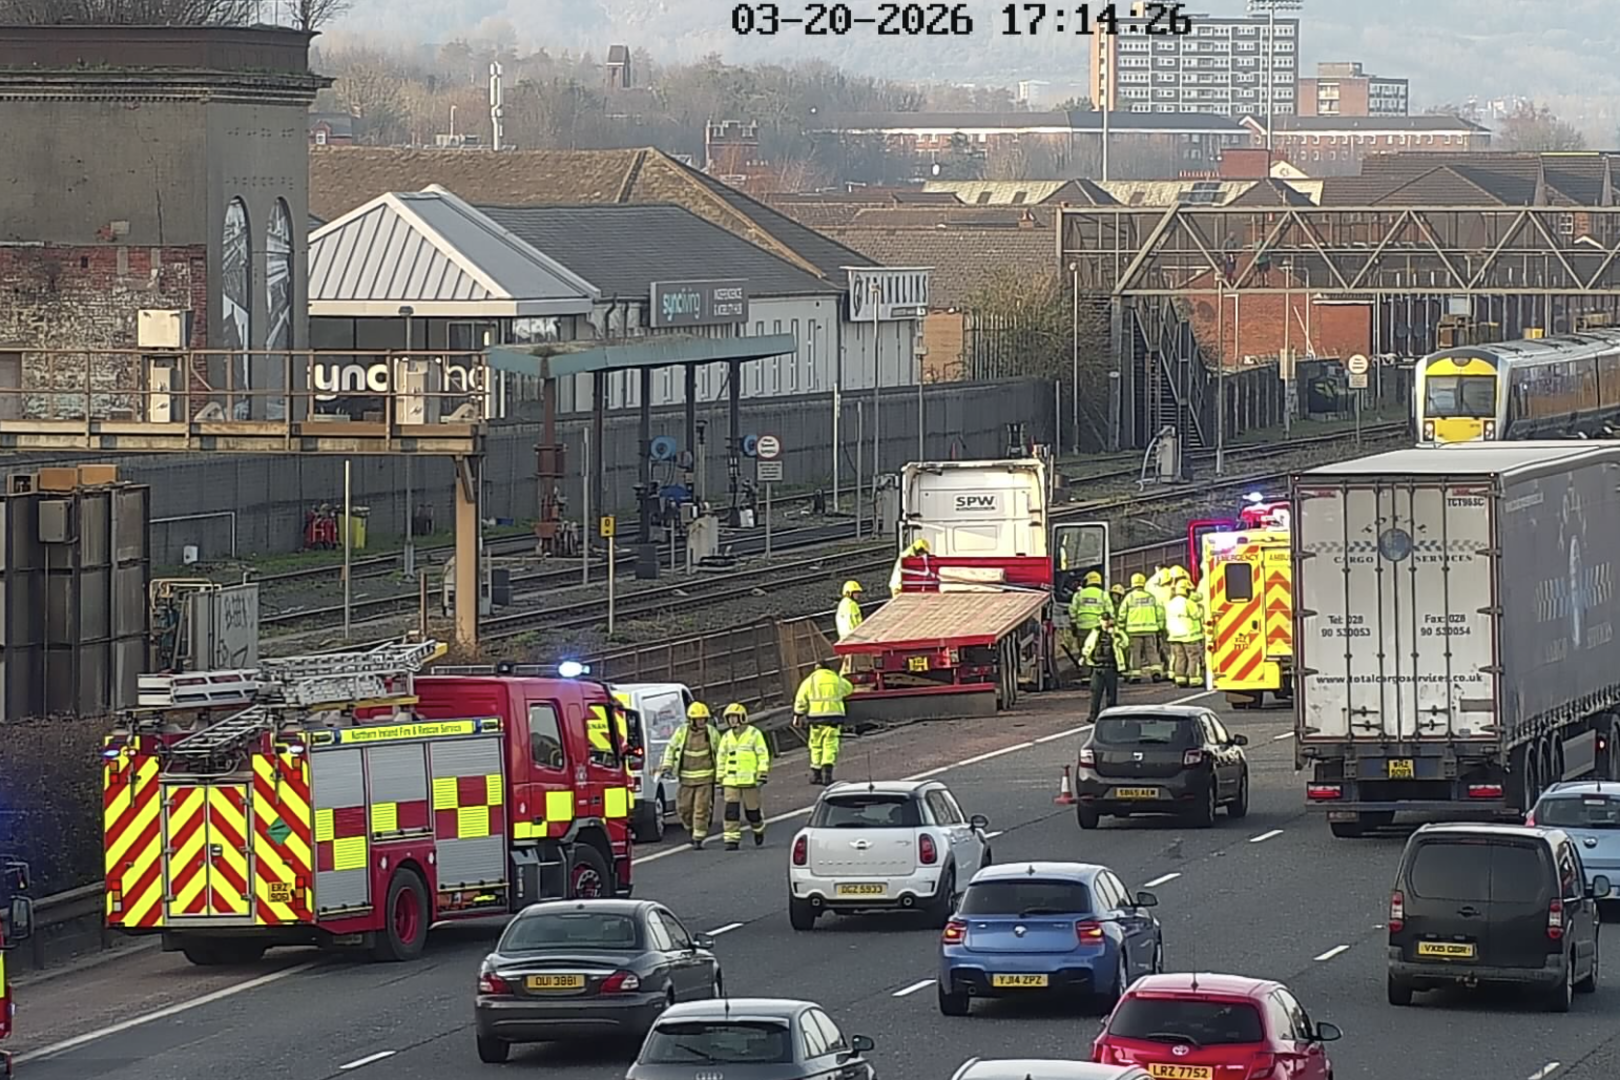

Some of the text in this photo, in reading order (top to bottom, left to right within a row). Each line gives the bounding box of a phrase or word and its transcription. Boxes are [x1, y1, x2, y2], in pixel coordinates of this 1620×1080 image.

[955, 495, 995, 507] SPW
[1152, 1064, 1208, 1079] LRZ 7752
